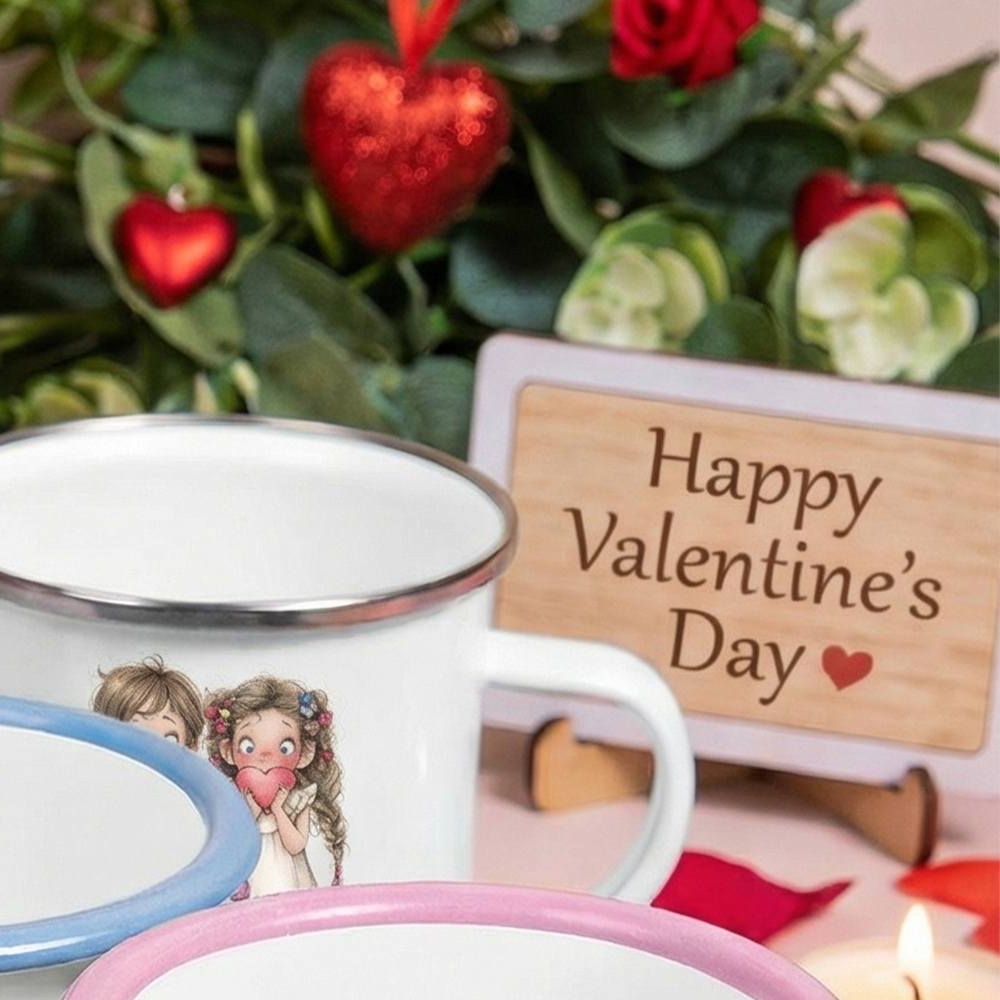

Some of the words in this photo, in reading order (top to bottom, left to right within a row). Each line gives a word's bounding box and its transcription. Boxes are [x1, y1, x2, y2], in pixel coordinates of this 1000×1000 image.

[647, 426, 883, 539] Happy
[563, 507, 943, 620] Valentine’s
[668, 607, 806, 706] Day
